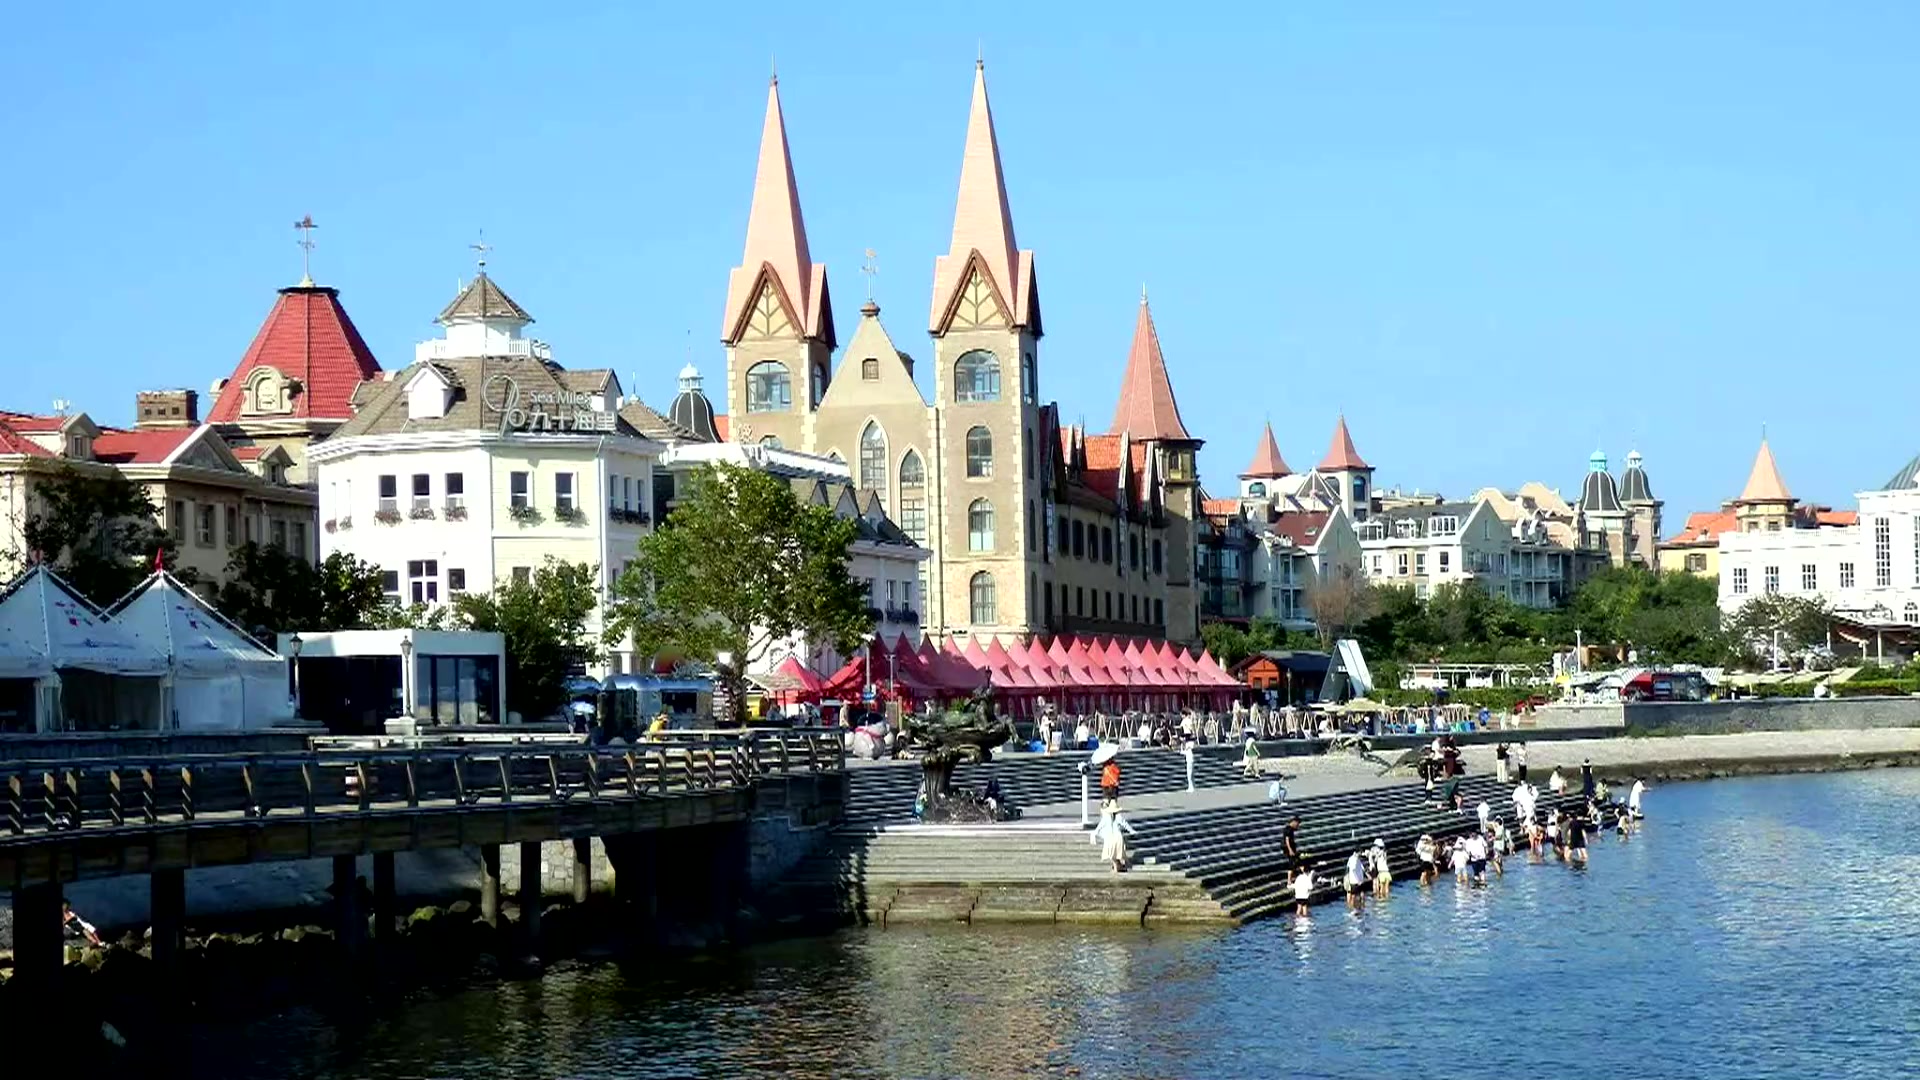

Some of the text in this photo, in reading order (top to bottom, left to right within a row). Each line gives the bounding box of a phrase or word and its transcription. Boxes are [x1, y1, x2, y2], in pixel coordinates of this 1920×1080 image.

[530, 391, 592, 404] Sea Miles
[529, 409, 616, 431] 九十海里
